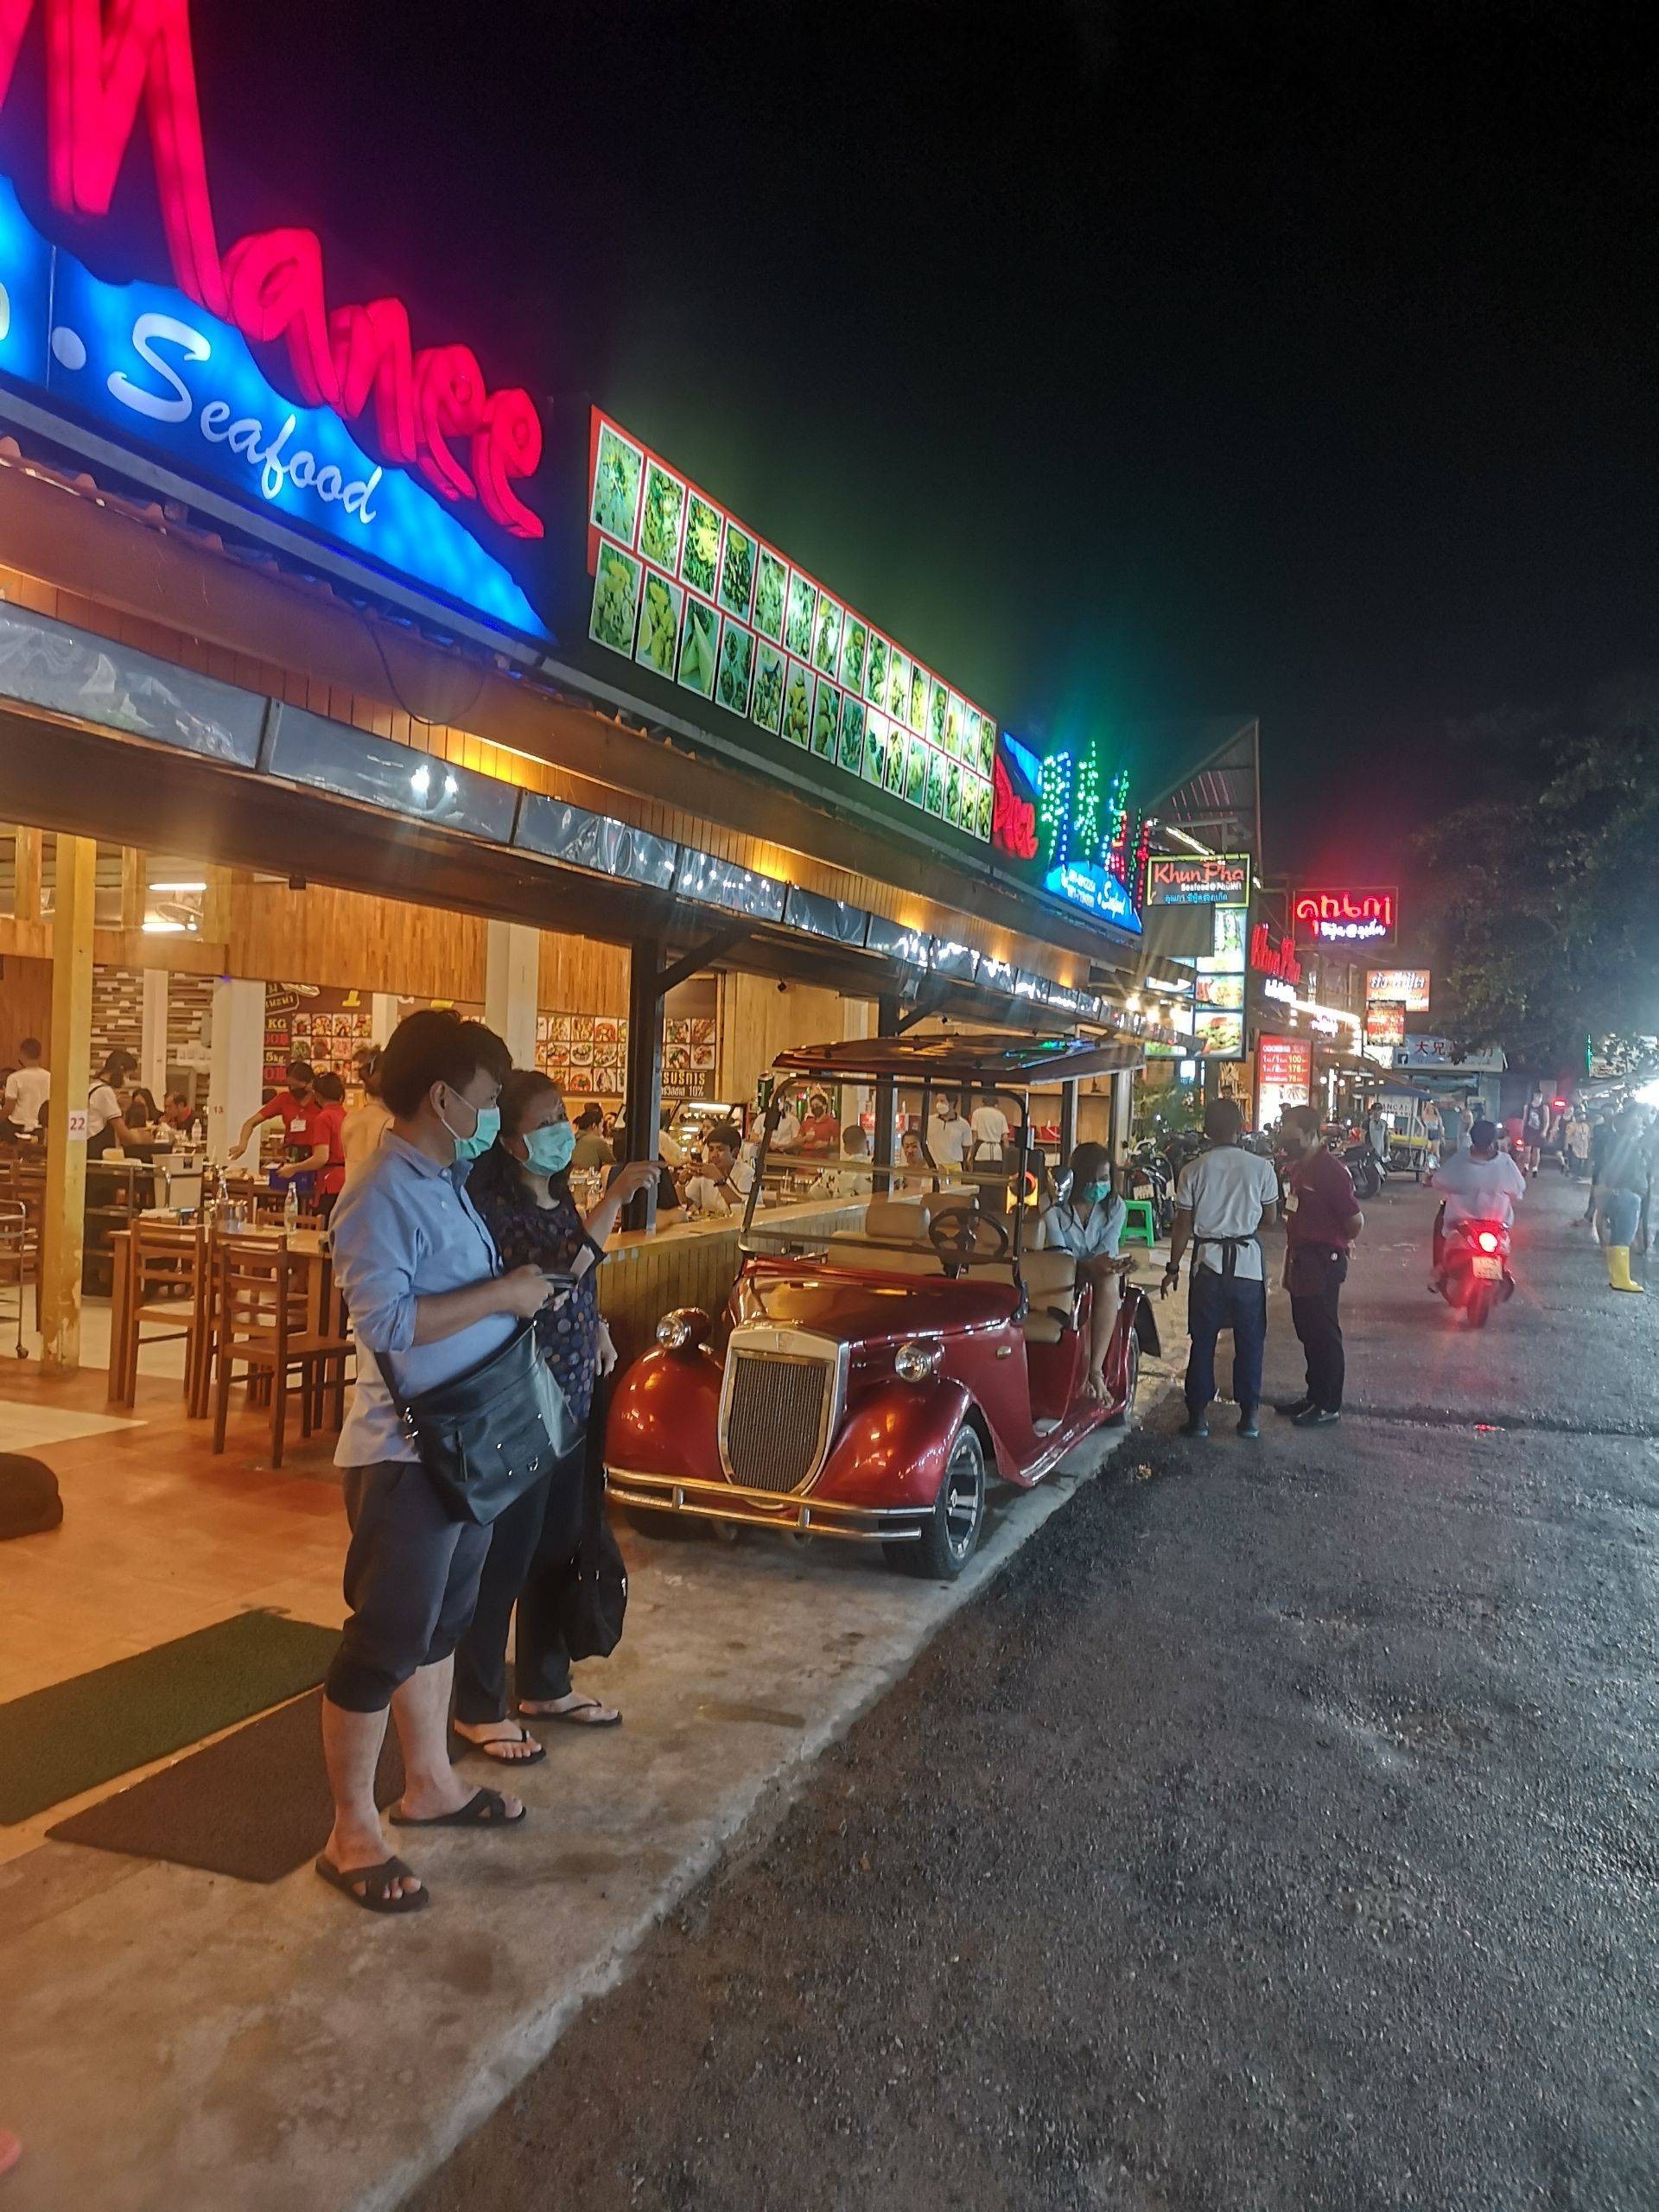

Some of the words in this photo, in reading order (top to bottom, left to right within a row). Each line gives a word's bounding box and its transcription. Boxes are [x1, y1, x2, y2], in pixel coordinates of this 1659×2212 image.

[107, 313, 383, 524] Seafood
[1154, 862, 1202, 884] Khun
[1202, 861, 1245, 883] Pha
[268, 1018, 287, 1029] KG
[689, 1086, 704, 1097] 10%
[69, 1117, 86, 1131] 22
